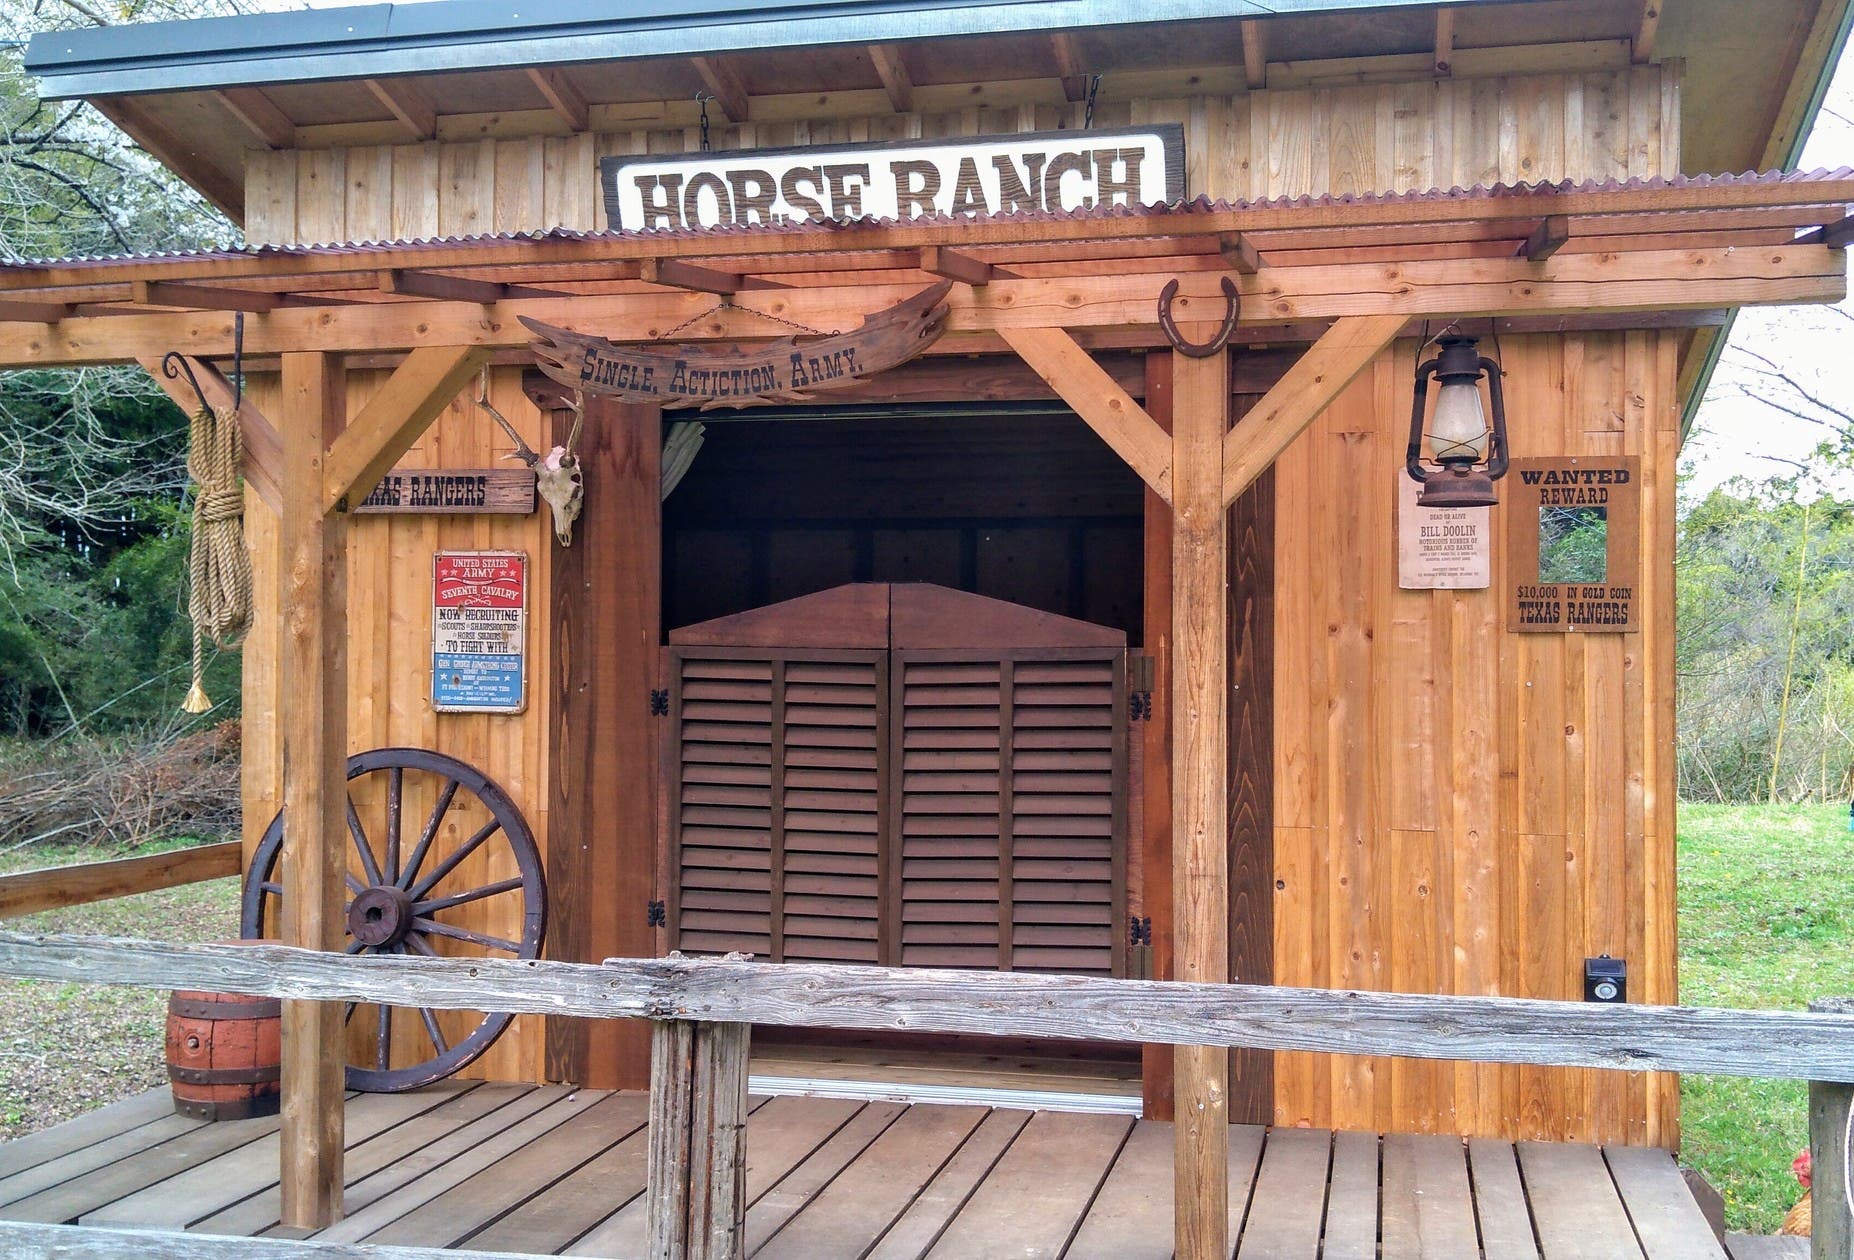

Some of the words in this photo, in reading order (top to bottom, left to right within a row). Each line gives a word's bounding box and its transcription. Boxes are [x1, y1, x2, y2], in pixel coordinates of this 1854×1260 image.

[634, 162, 871, 228] HORSE
[890, 147, 1145, 220] RANCH
[580, 348, 658, 395] SINGLE,
[1520, 470, 1630, 485] WANTED
[409, 476, 487, 506] RANGERS
[1540, 487, 1609, 505] REWARD
[1421, 526, 1440, 537] BILL
[1443, 525, 1476, 537] DOOLIN
[452, 558, 480, 568] UNITED
[482, 559, 509, 568] STATES
[463, 568, 495, 578] ARMY
[441, 586, 478, 599] SEVENTH
[481, 586, 519, 601] CAVALRY
[1567, 587, 1578, 599] IN
[1582, 587, 1605, 600] GOLD
[1610, 587, 1632, 600] COIN
[439, 608, 461, 620] NOW
[465, 609, 519, 621] RECRUITING
[1518, 601, 1560, 624] TEXAS
[1567, 602, 1629, 625] RANGERS
[446, 640, 458, 652] TO
[460, 640, 484, 653] FIGHT
[487, 641, 508, 653] WITH
